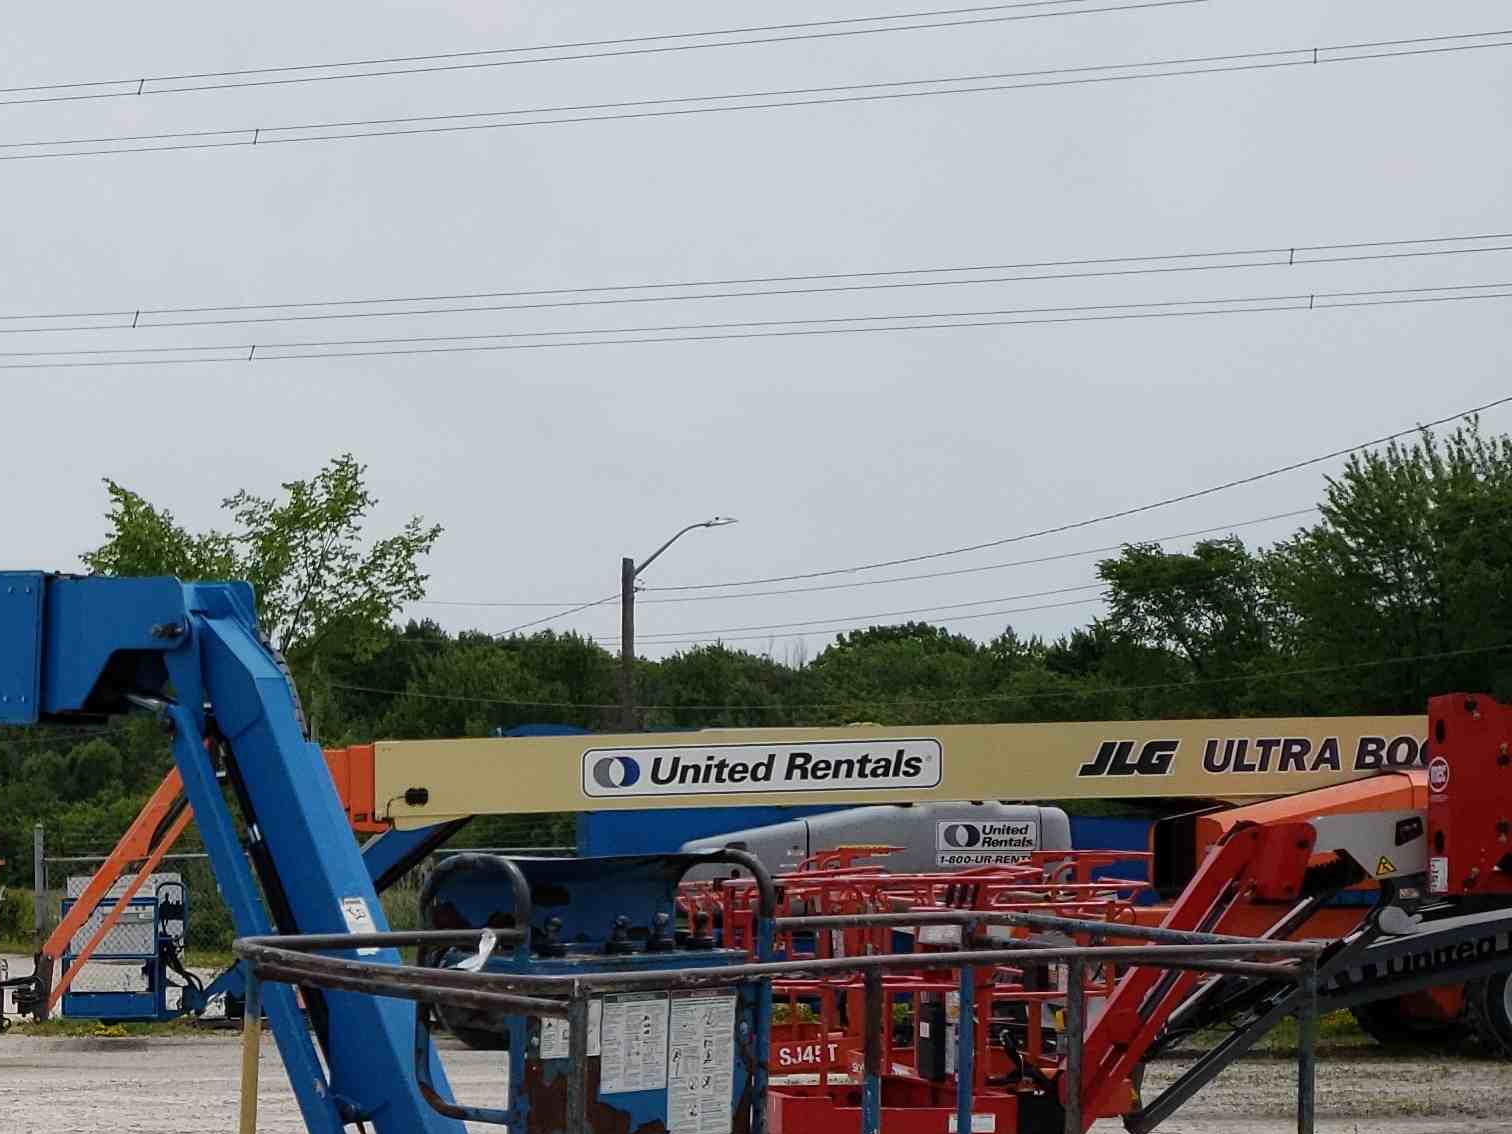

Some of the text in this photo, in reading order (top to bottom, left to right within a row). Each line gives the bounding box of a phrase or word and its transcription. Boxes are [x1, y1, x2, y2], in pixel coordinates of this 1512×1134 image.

[650, 750, 923, 785] United Rentals
[1078, 740, 1180, 777] JLG
[1203, 737, 1342, 772] ULTRA
[981, 824, 1030, 836] United
[981, 836, 1033, 848] Rentals
